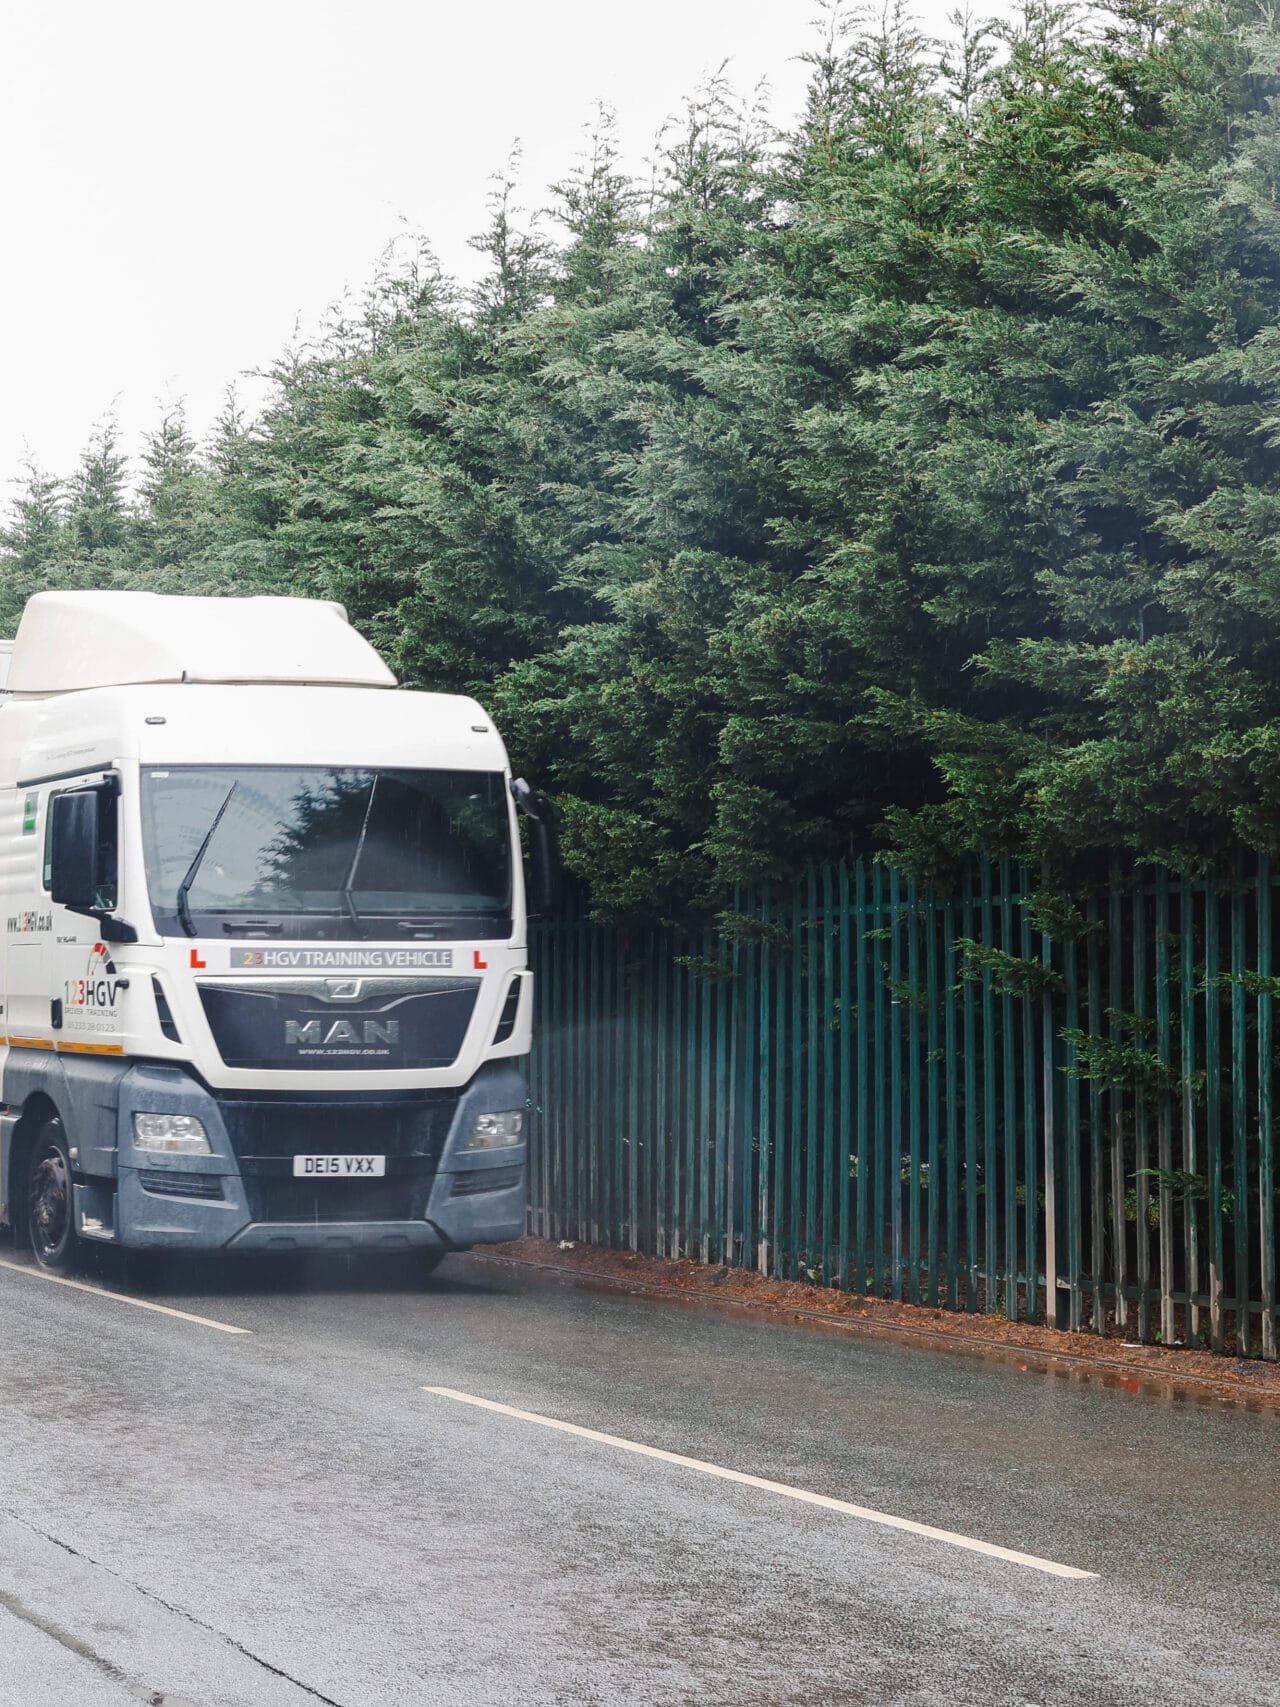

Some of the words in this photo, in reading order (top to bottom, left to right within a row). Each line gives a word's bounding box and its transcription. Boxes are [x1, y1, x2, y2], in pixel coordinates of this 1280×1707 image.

[190, 949, 206, 968] L
[302, 950, 383, 966] TRAINING
[384, 950, 452, 967] VEHICLE
[474, 950, 487, 969] L
[64, 980, 117, 1007] 123HGV
[284, 1020, 400, 1044] MAN
[305, 1157, 340, 1173] DE15
[344, 1157, 375, 1173] VXX
